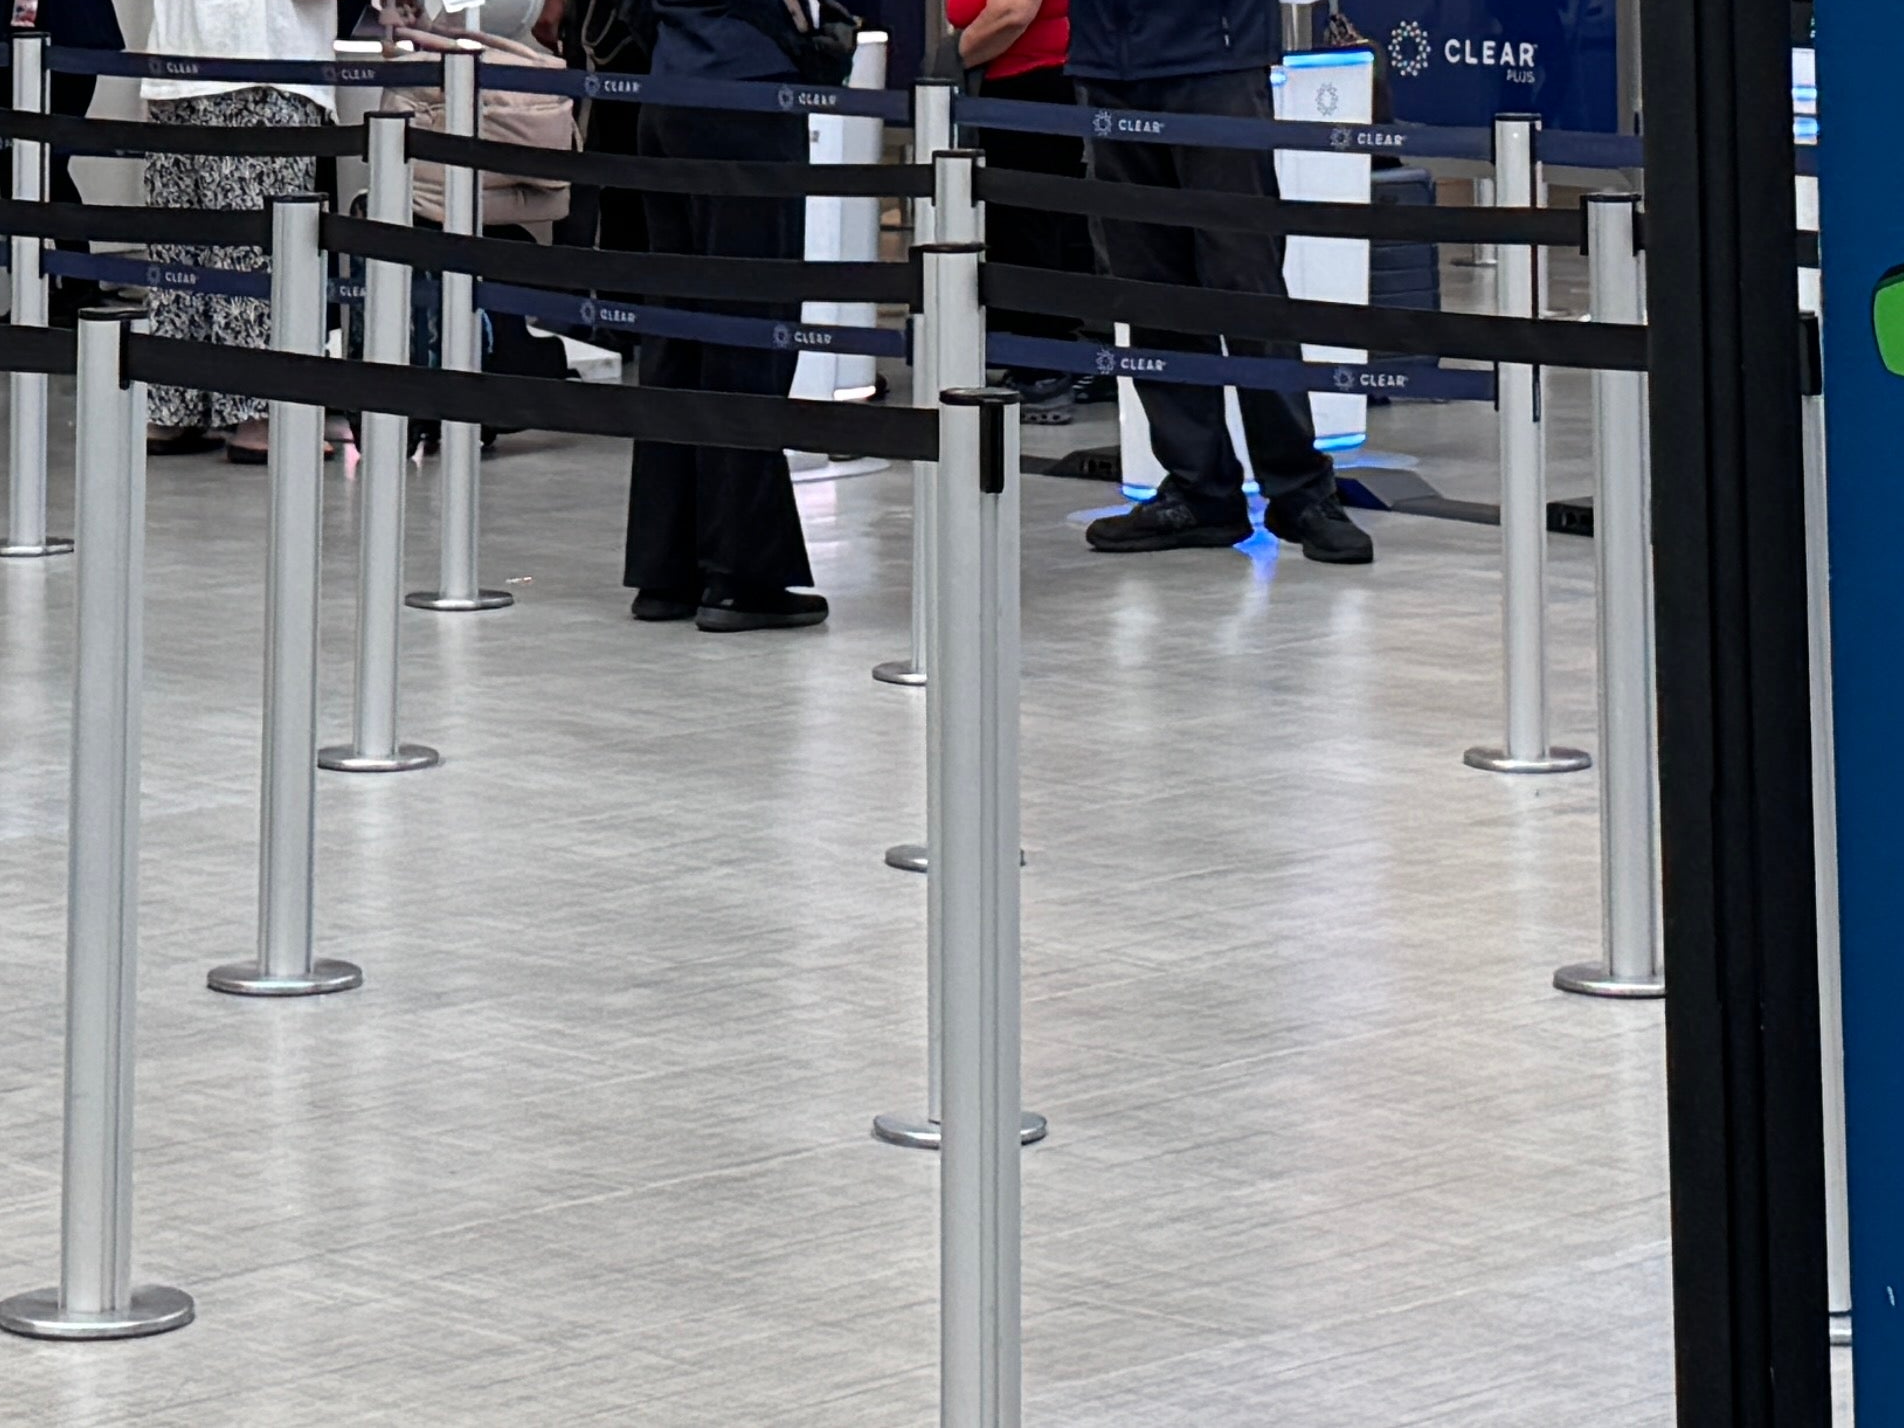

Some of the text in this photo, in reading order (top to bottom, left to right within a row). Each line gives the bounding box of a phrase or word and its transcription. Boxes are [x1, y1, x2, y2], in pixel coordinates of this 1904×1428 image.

[1443, 37, 1536, 68] CLEAR
[166, 62, 199, 76] CLEAR
[341, 68, 376, 81] CLEAR
[1506, 69, 1536, 84] PLUS
[1117, 118, 1163, 134] CLEAR
[1357, 132, 1405, 146] CLEAR
[165, 271, 198, 284] CLEAR
[339, 285, 367, 297] CLEA
[599, 308, 637, 323] CLEAR
[793, 331, 833, 345] CLEAR
[1120, 357, 1166, 372] CLEAR
[1359, 373, 1408, 388] CLEAR
